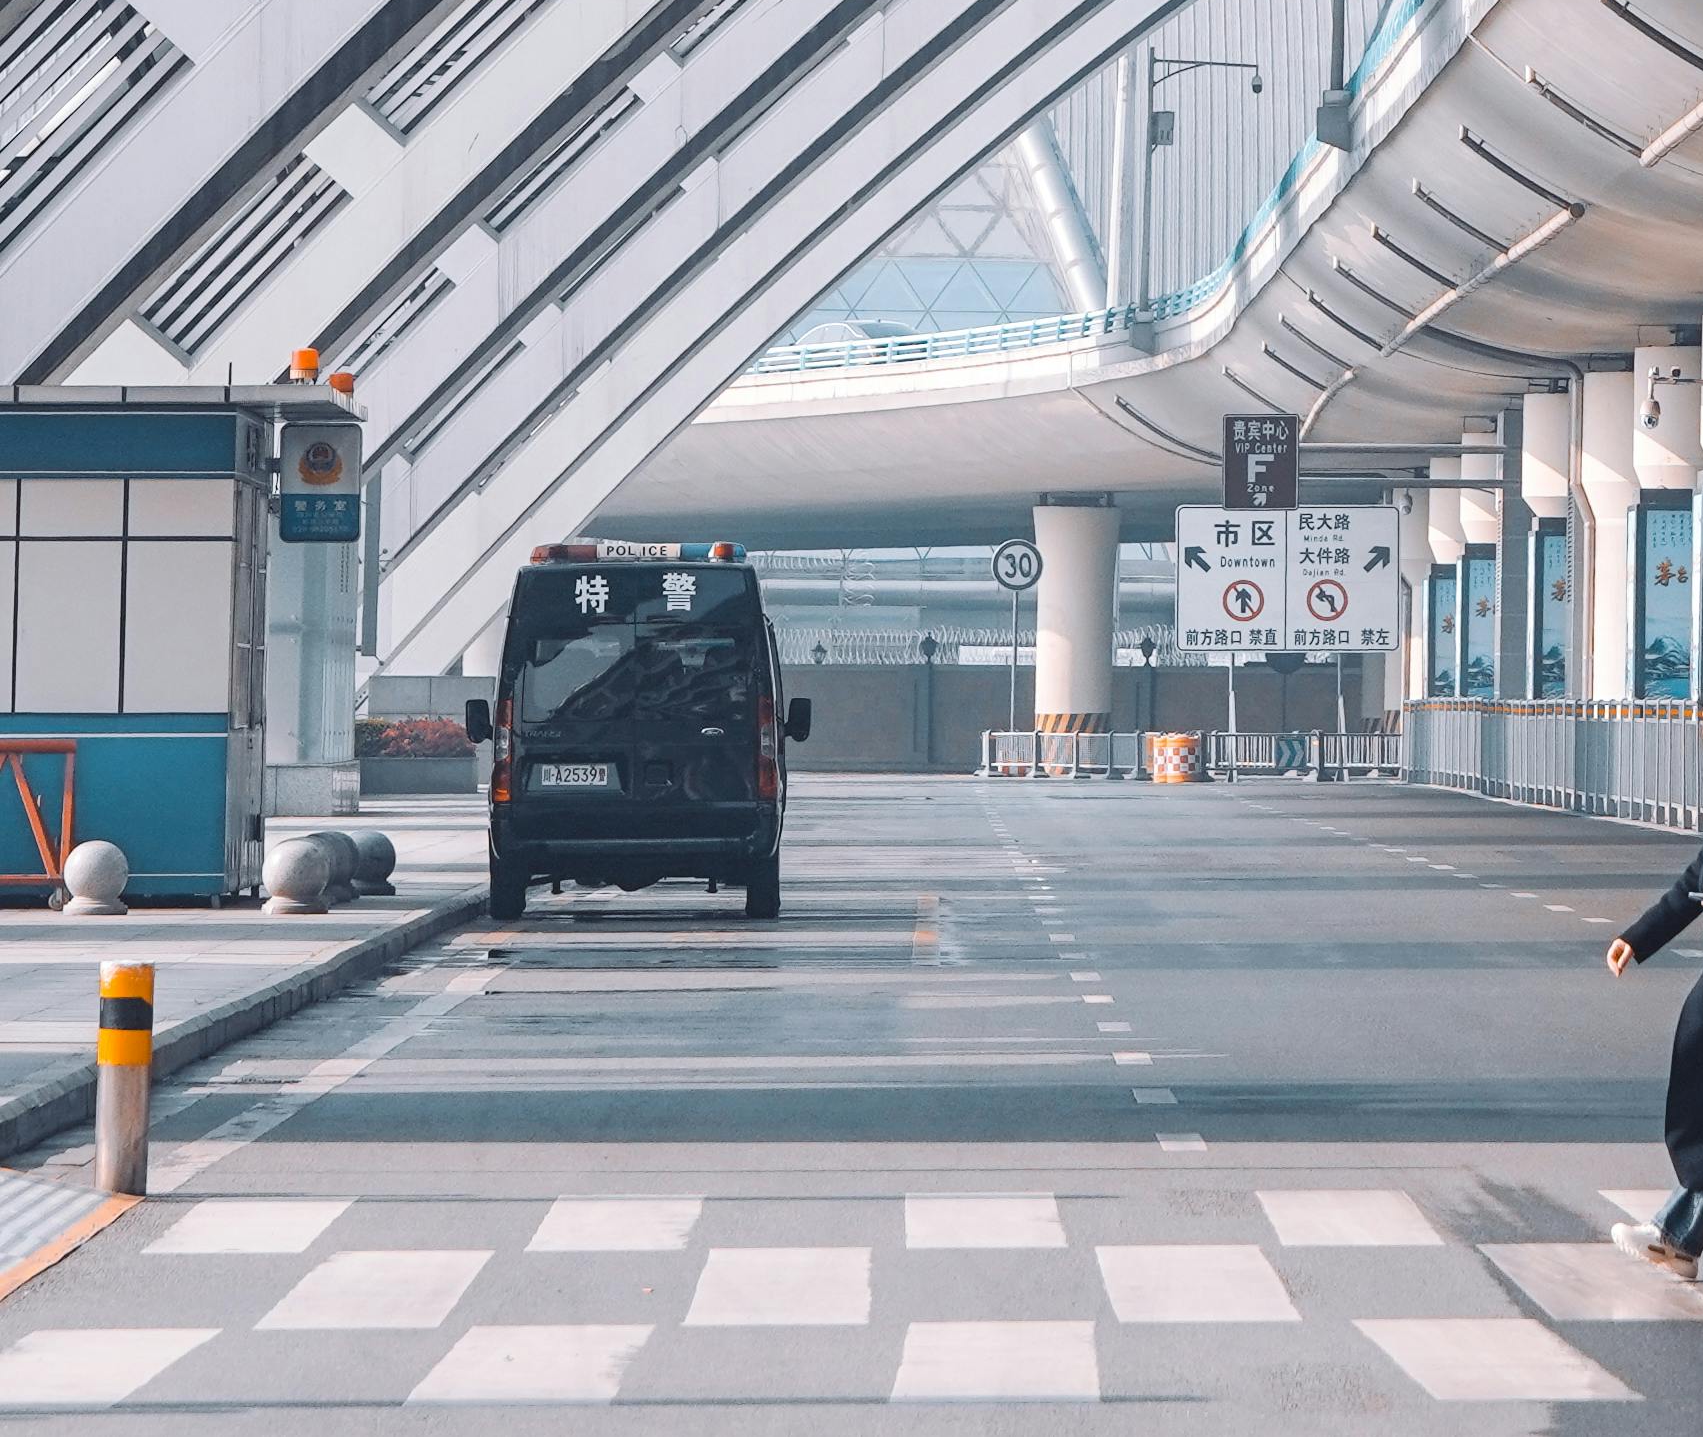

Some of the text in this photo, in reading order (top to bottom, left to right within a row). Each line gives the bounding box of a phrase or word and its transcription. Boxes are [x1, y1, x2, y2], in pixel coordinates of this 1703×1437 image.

[1233, 420, 1289, 441] 贵宾中心
[1235, 442, 1288, 454] VIP Center
[1248, 454, 1275, 483] F
[1247, 484, 1275, 492] Zone
[1299, 513, 1351, 531] 民大路
[1214, 520, 1276, 547] 市区
[606, 545, 668, 557] POLICE
[1300, 547, 1351, 565] 大件路
[1005, 553, 1031, 578] 30
[1220, 556, 1276, 568] Downtown
[574, 572, 698, 614] 特警
[1186, 629, 1278, 646] 前方路口 禁直
[1294, 629, 1390, 646] 前方路口 禁左
